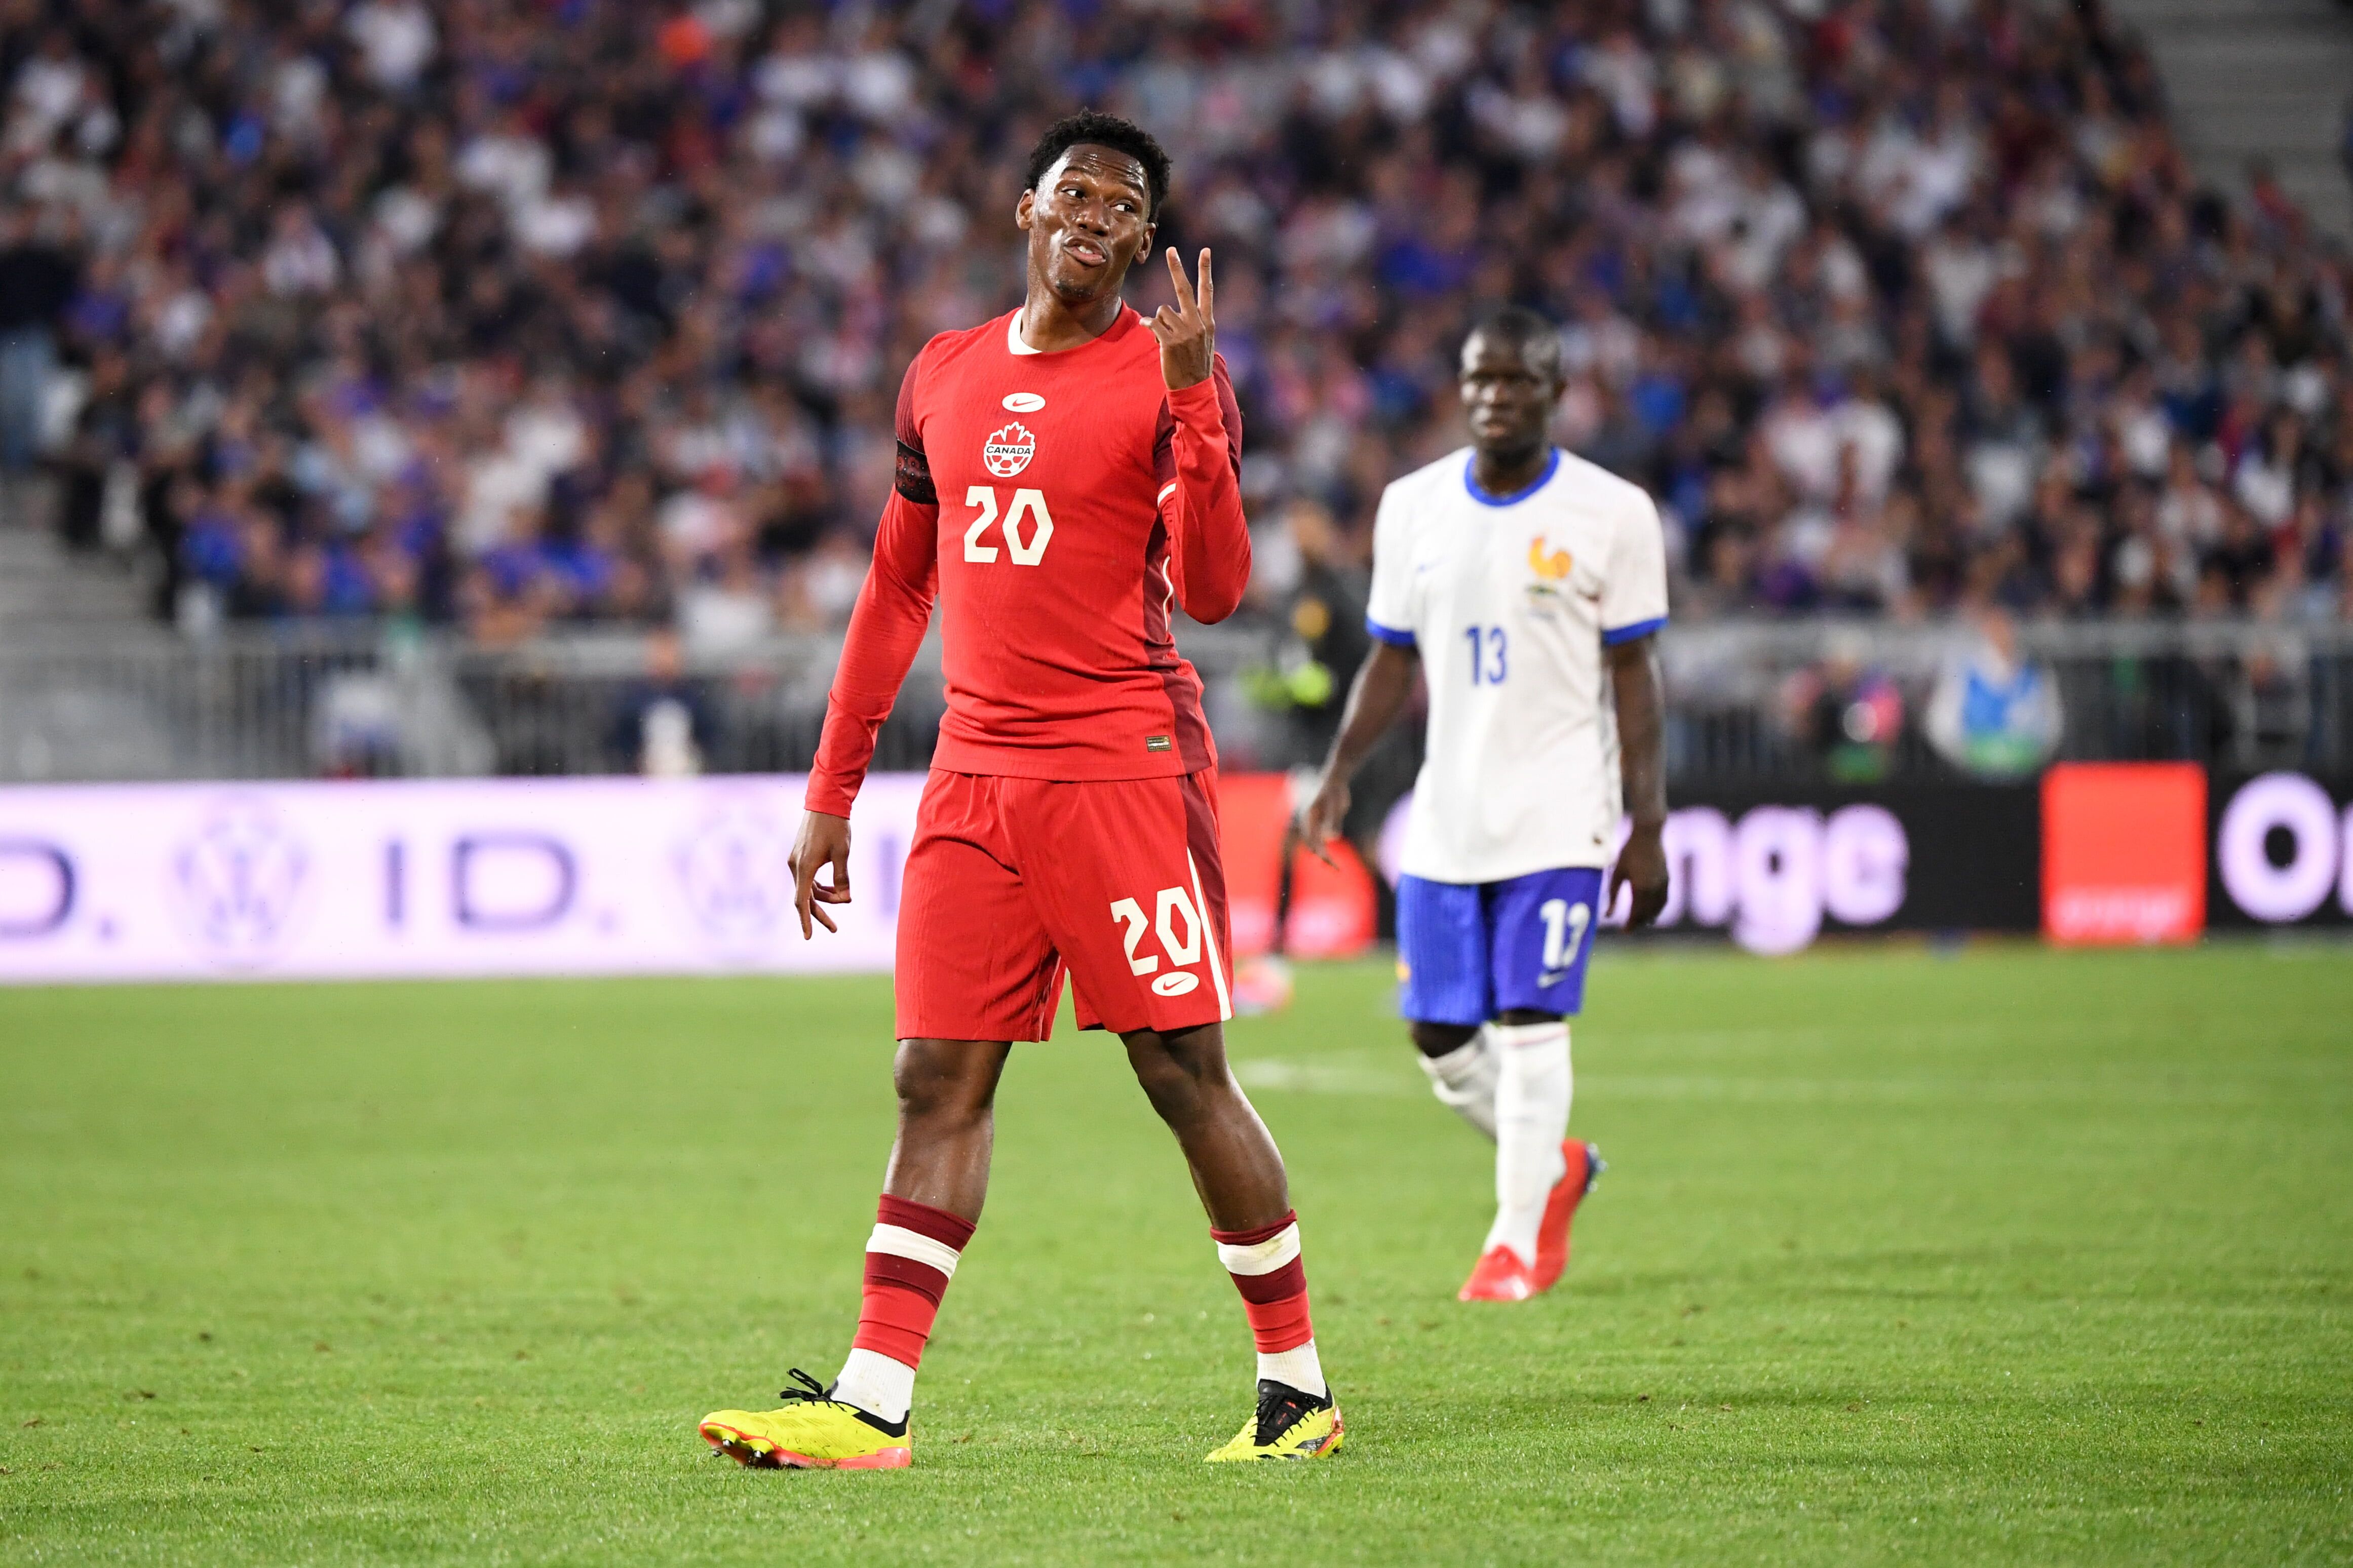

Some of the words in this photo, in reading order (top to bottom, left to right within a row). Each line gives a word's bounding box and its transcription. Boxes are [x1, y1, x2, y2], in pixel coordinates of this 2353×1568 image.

[986, 446, 1031, 455] CANADA
[963, 485, 1055, 566] 20
[1464, 625, 1509, 686] 13
[1110, 886, 1201, 976] 20
